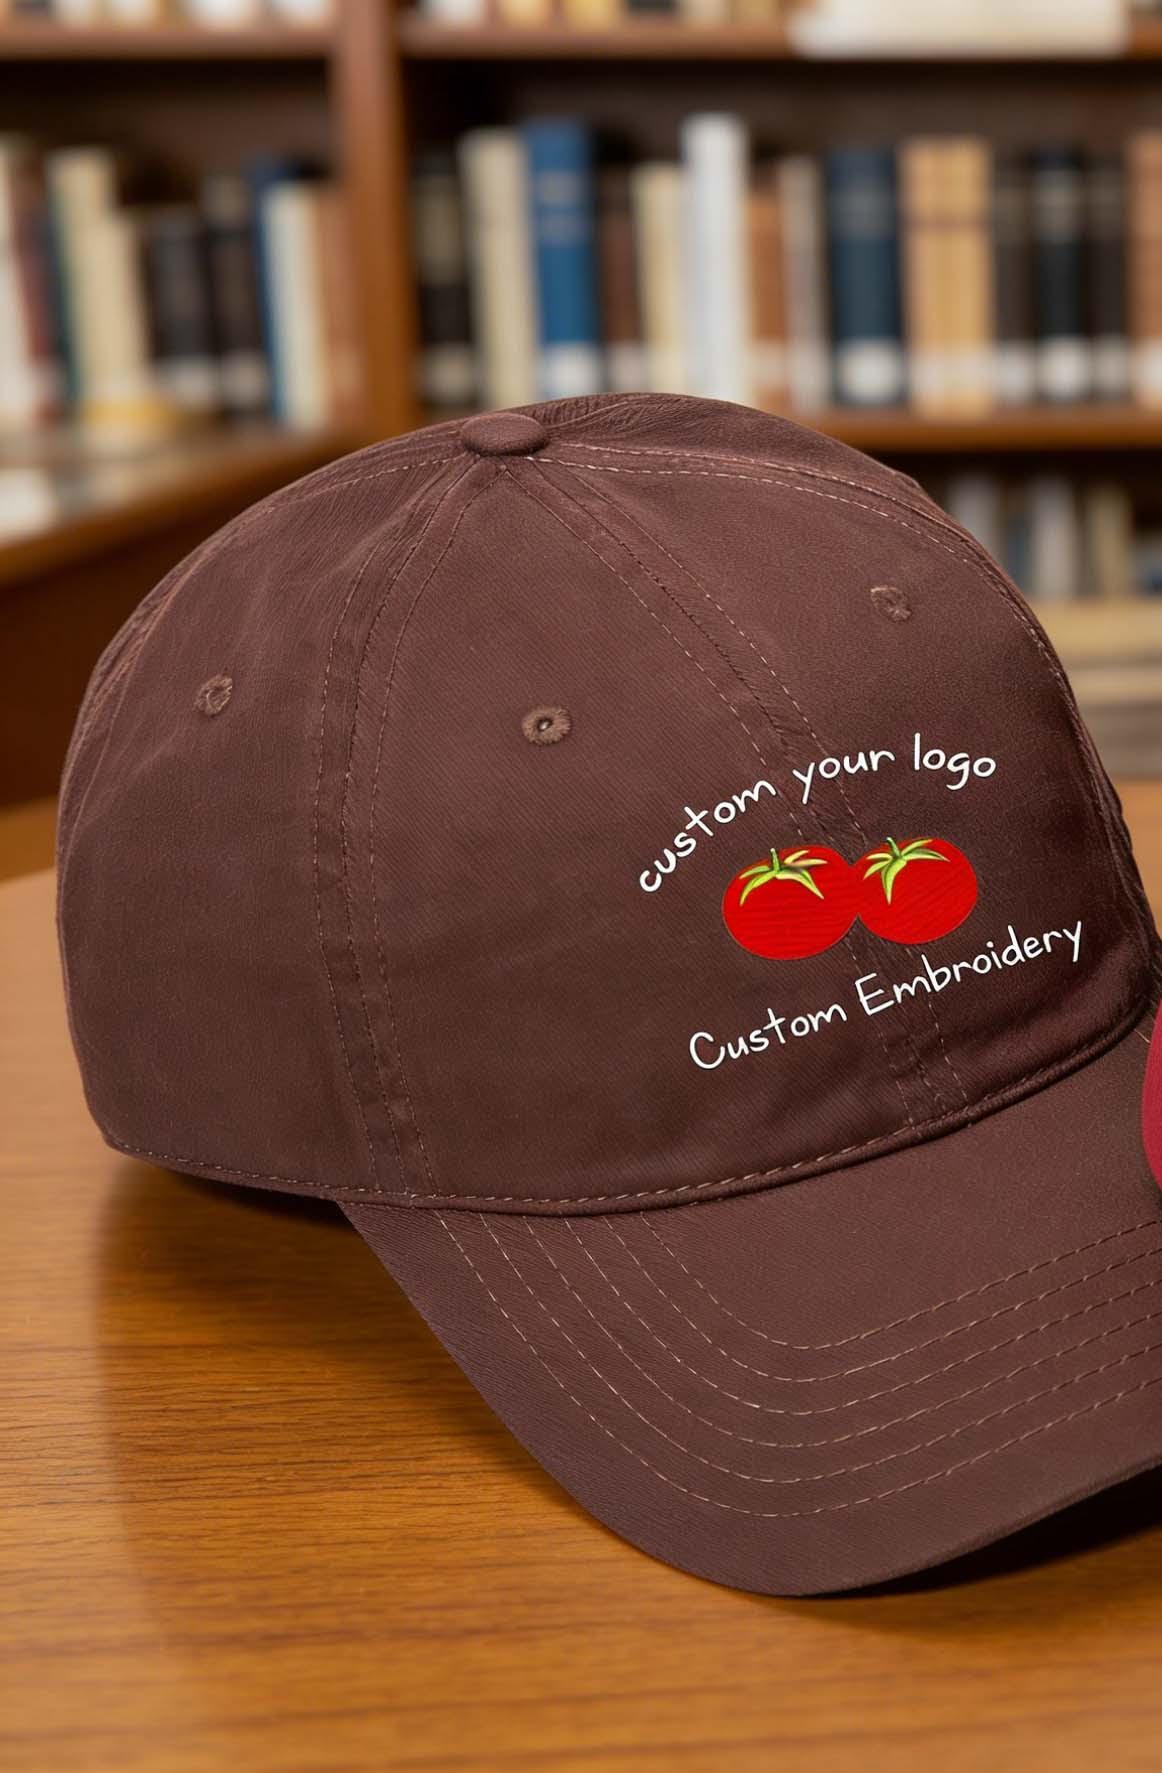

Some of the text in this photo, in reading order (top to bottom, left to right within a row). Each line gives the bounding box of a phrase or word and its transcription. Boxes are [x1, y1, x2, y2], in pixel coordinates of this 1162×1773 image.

[638, 732, 997, 893] custom your logo
[688, 920, 1083, 1071] Custom Embroidery
